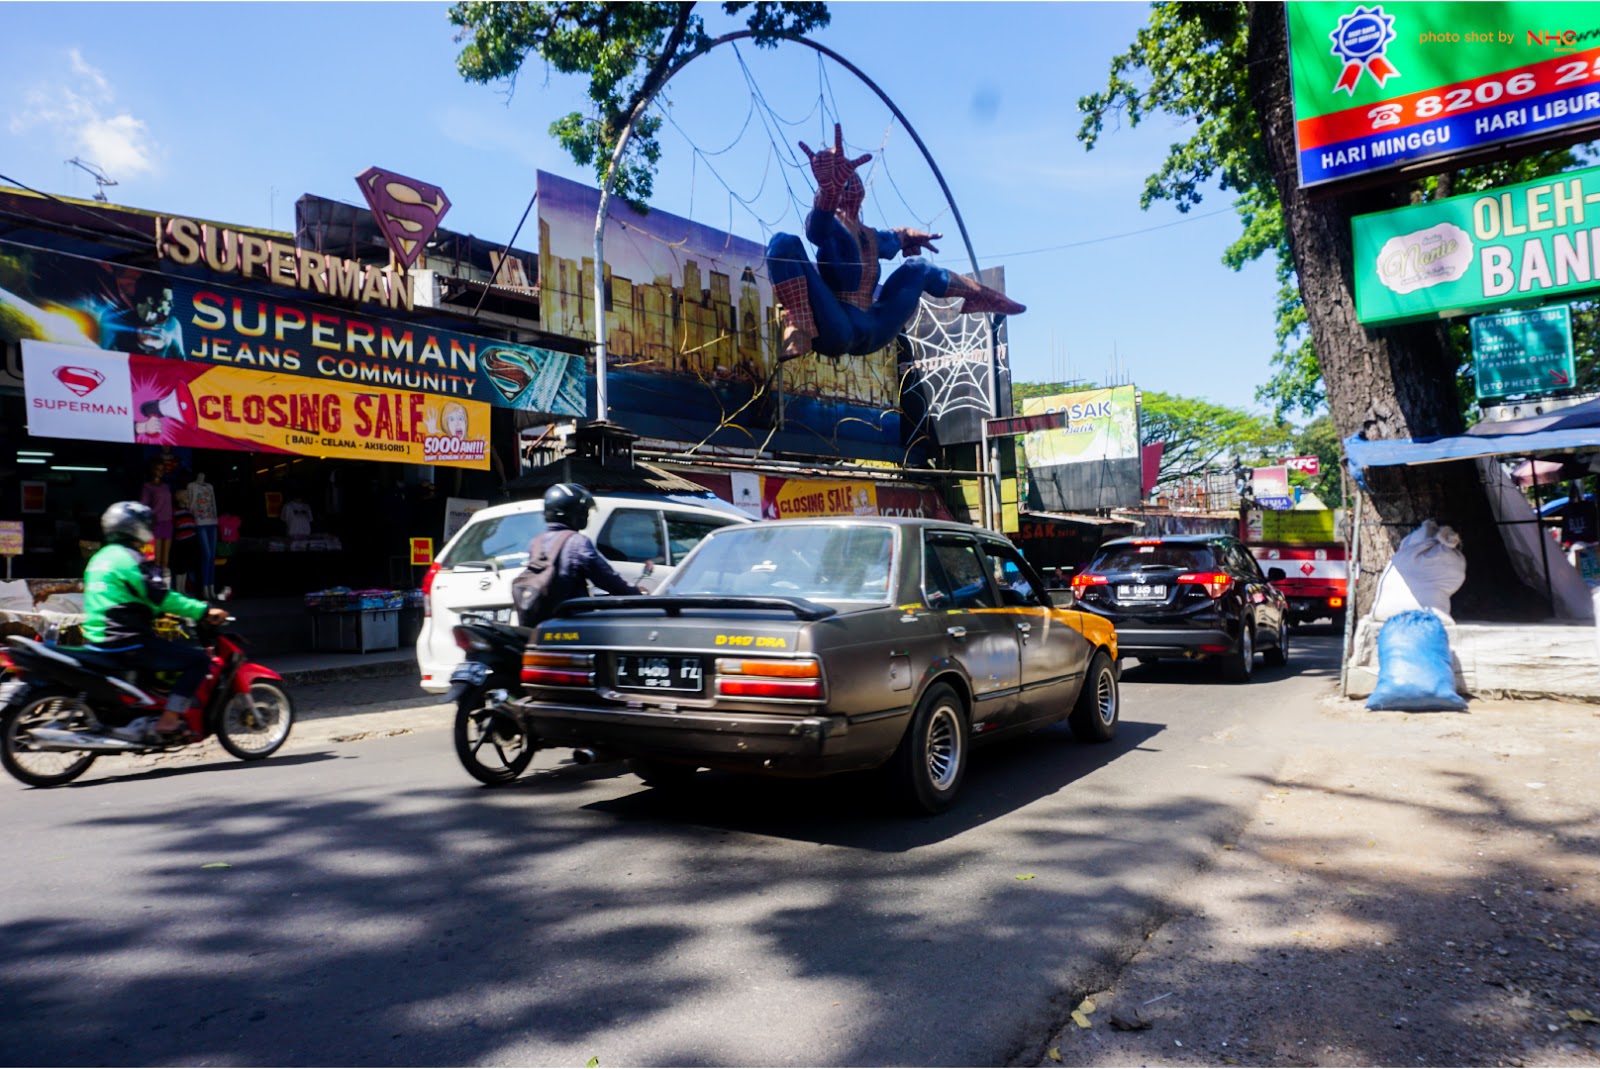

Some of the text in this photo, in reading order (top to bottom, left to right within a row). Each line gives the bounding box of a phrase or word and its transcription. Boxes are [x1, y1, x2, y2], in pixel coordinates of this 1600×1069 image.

[1415, 56, 1600, 117] 8206 2
[1475, 91, 1600, 135] HARI LIBUR
[1321, 125, 1450, 169] HARI MINGGU
[166, 217, 415, 312] SUPERMAN
[191, 291, 477, 373] SUPERMAN
[1479, 311, 1564, 329] WARUNG GAUL
[191, 336, 477, 396] JEANS COMMUNITY
[33, 398, 128, 416] SUPERMAN
[198, 393, 426, 443] CLOSING SALE
[291, 434, 405, 453] BAJU CELANA AKSESORIS
[1287, 457, 1317, 470] KFC
[780, 492, 824, 513] CLOSING
[827, 486, 854, 512] SALE
